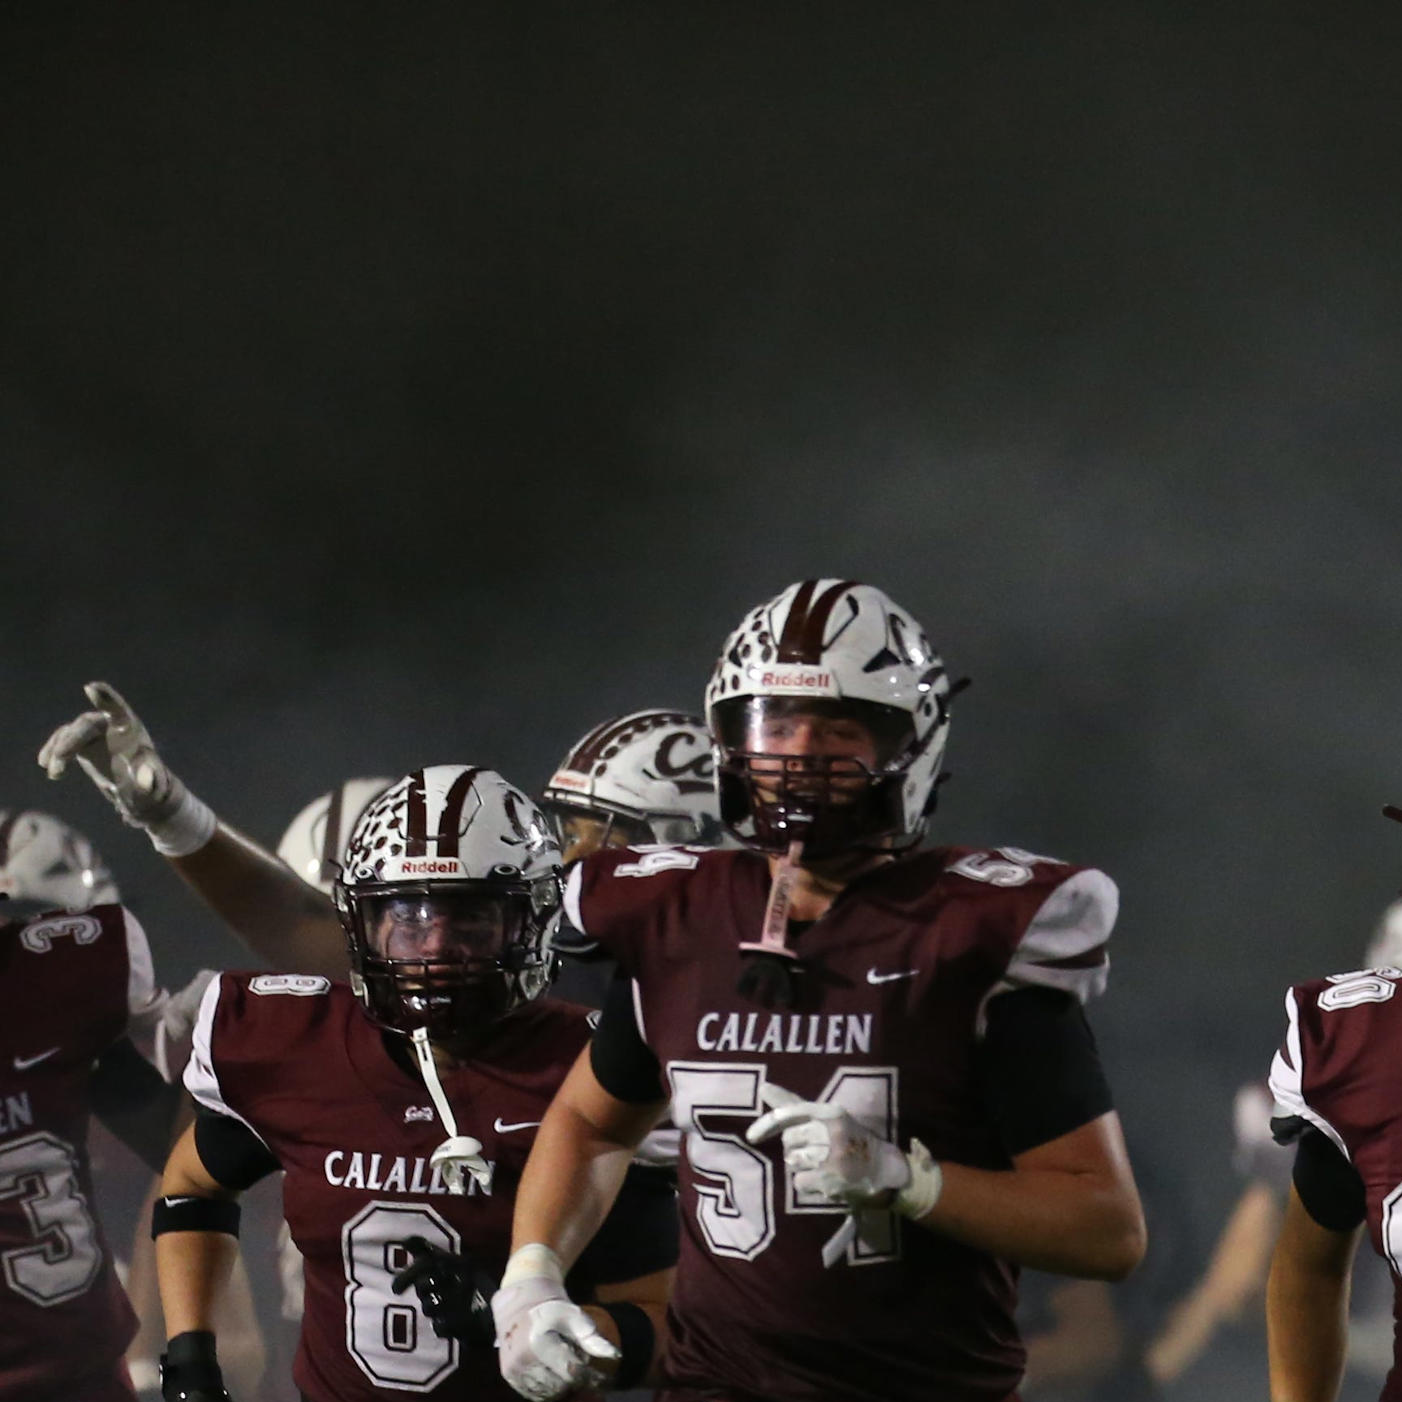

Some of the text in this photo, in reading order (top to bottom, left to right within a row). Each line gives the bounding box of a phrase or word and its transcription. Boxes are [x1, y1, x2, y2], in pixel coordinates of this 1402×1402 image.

[762, 673, 831, 688] Riddell
[655, 731, 716, 778] Ca
[401, 861, 459, 874] Riddell
[698, 1012, 873, 1055] CALALLEN
[324, 1150, 496, 1197] CALALLN
[667, 1061, 899, 1276] 54
[341, 1200, 461, 1394] 8
